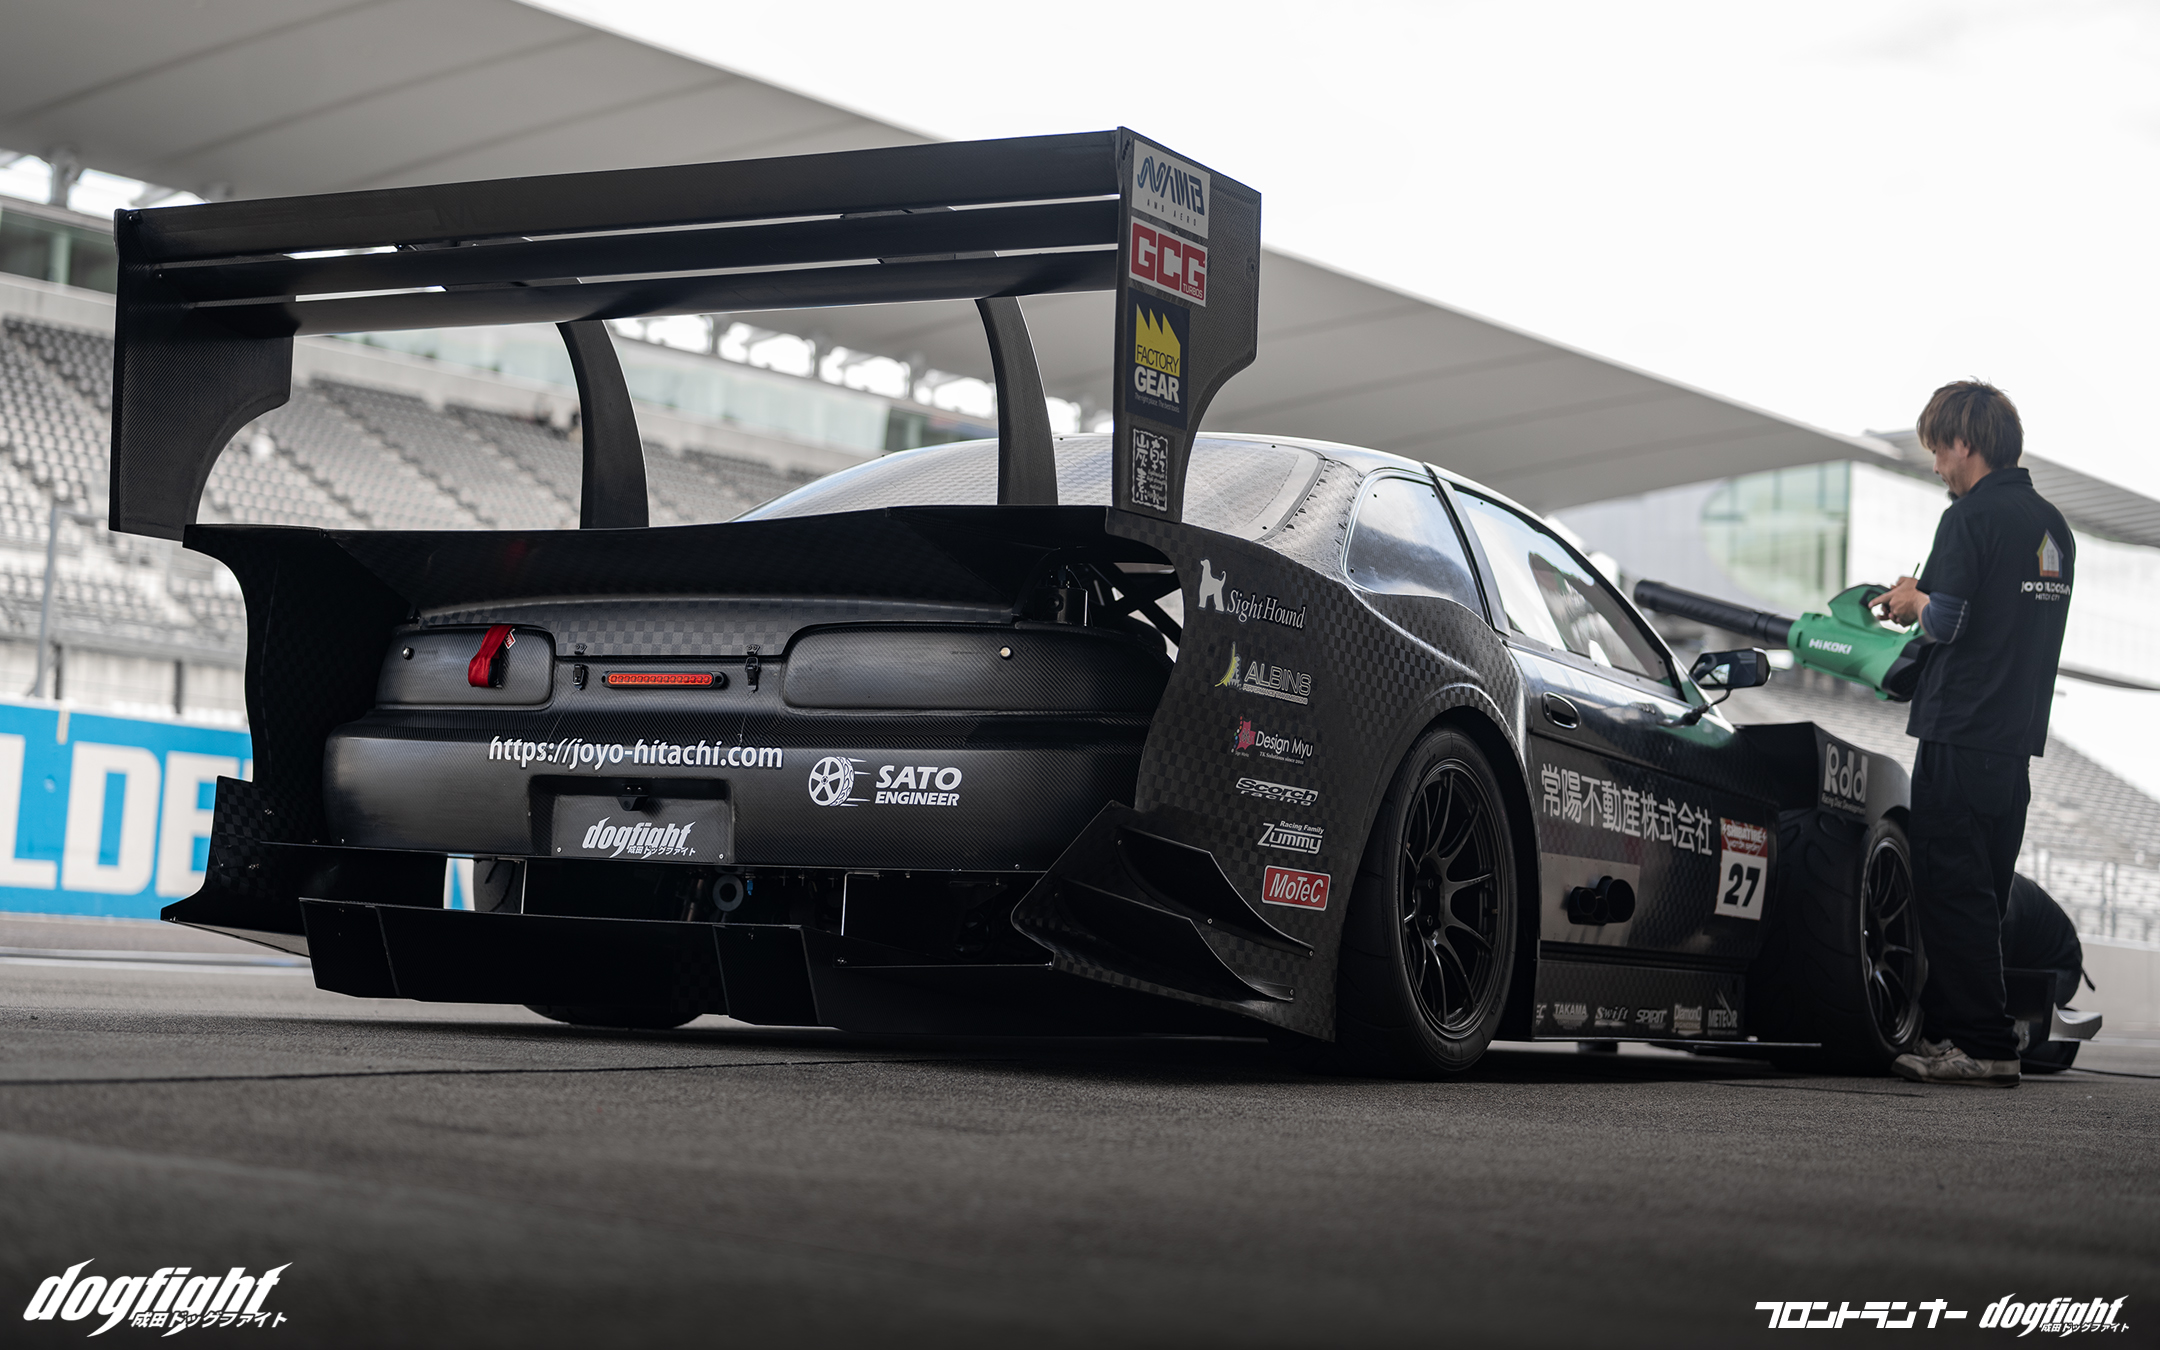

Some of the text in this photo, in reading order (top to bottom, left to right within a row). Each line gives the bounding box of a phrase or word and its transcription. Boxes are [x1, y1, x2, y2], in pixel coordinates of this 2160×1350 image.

[1131, 222, 1206, 301] GCG
[1182, 282, 1203, 299] TURBOS
[1136, 344, 1179, 373] FACTORY
[1134, 366, 1180, 404] GEAR
[1227, 590, 1306, 629] Sight Hound
[1808, 638, 1852, 655] HiKOKI
[1244, 661, 1312, 696] ALBINS
[489, 736, 784, 769] https://joyo-hitachi.com
[1255, 731, 1313, 759] Design Myu
[875, 765, 962, 790] SATO
[1824, 742, 1868, 803] Rdd
[875, 791, 960, 807] ENGINEER
[1237, 779, 1318, 801] Scorch
[1240, 789, 1311, 806] racing
[0, 732, 252, 897] LDE
[1541, 763, 1712, 856] 常陽不動産株式会社
[581, 816, 696, 860] dogfight
[1257, 822, 1322, 855] Zummy
[1280, 820, 1325, 835] Racing Family
[627, 845, 696, 857] 成田ドッグファイト
[1268, 872, 1324, 904] MoTeC
[1723, 863, 1761, 907] 27
[1596, 1006, 1629, 1021] Swift
